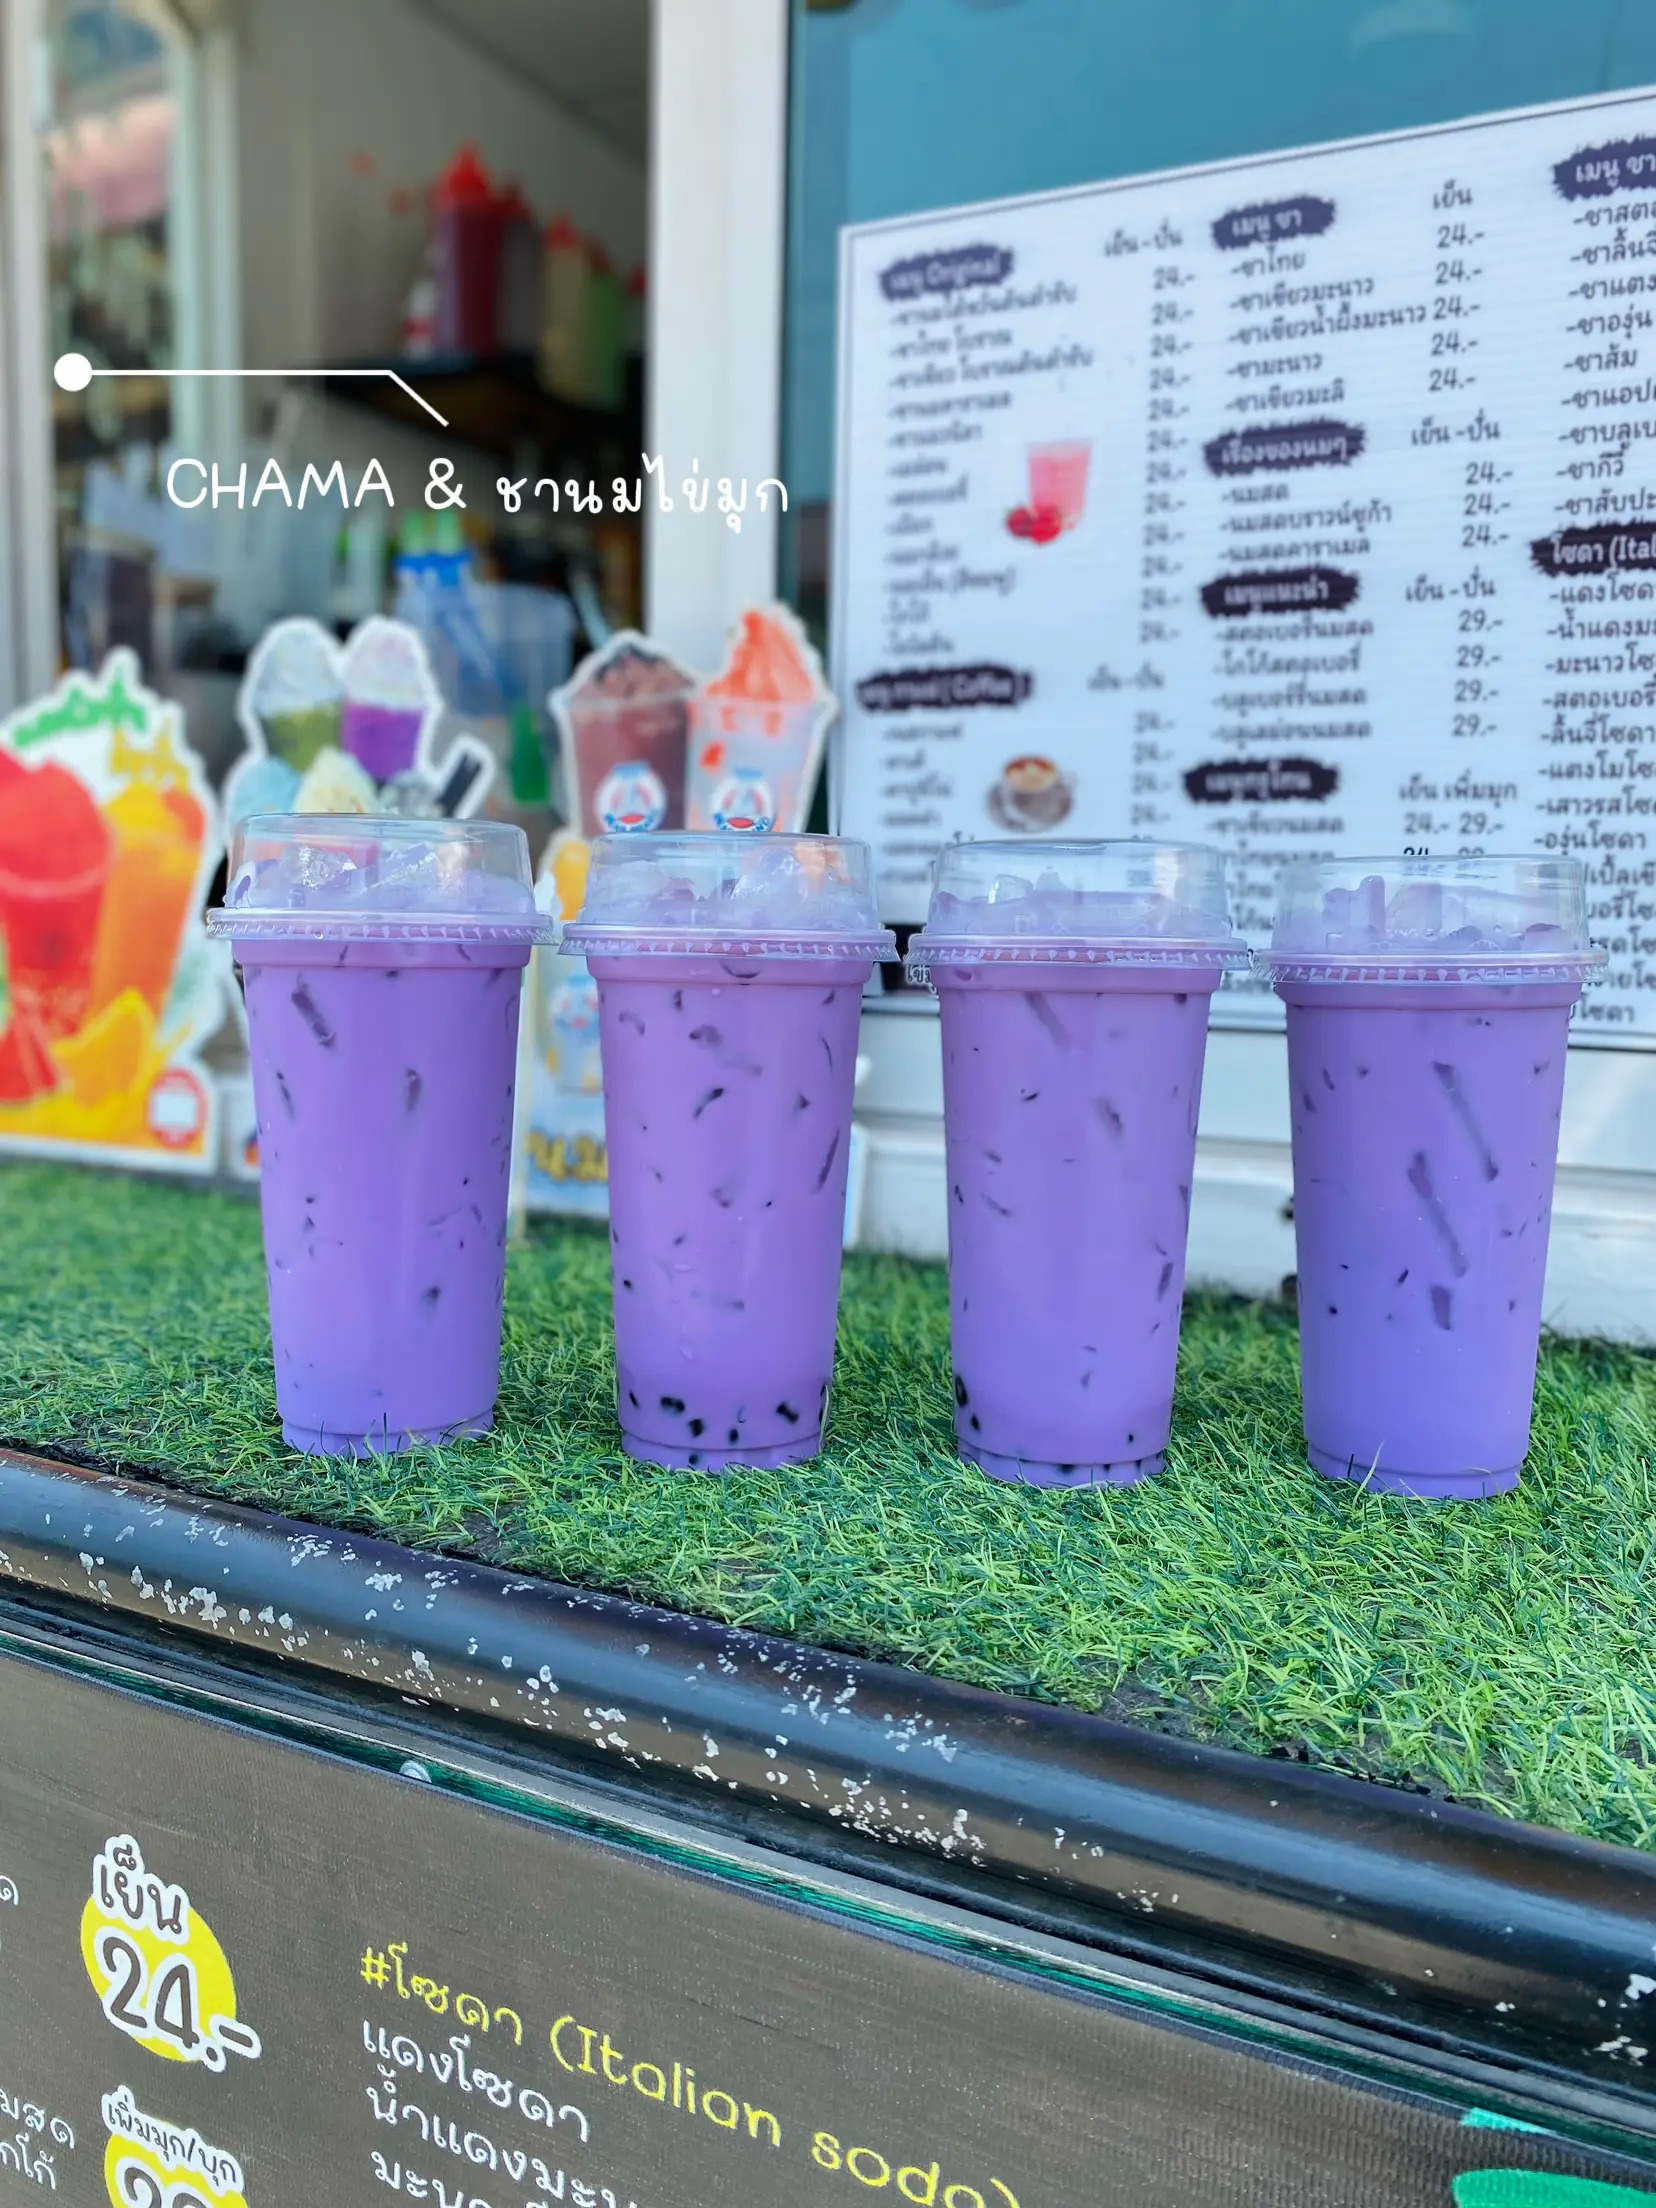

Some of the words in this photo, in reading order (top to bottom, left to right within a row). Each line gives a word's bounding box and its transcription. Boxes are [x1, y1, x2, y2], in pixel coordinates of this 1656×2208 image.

[1576, 158, 1620, 188] เมนู
[1433, 178, 1474, 211] เย็น
[1232, 213, 1271, 243] เมนู
[1274, 208, 1303, 231] ชา
[1436, 223, 1485, 249] 24.-
[1153, 265, 1196, 291] 24.-
[1435, 260, 1482, 286] 24.-
[1151, 301, 1194, 326] 24.-
[1432, 295, 1480, 321] 24.-
[1565, 302, 1654, 340] -ชาองุ่น
[1430, 331, 1478, 356] 24.-
[1563, 342, 1638, 373] -ชาส้ม
[1428, 367, 1476, 392] 24.-
[1465, 461, 1513, 486] 24.-
[1555, 450, 1625, 480] -ชากีวี
[1463, 492, 1511, 517] 24.-
[1461, 524, 1509, 549] 24.-
[1550, 531, 1605, 565] โซดา
[1458, 609, 1503, 633] 29.-
[1456, 644, 1501, 668] 29.-
[1453, 679, 1499, 703] 29.-
[1451, 713, 1497, 738] 29.-
[1399, 772, 1438, 801] เย็น
[1444, 767, 1518, 810] เพิ่มมุก
[1404, 812, 1450, 836] 24.-
[1458, 812, 1505, 836] 29.-
[1534, 819, 1647, 857] -องุ่นโซดา
[100, 1845, 183, 1936] เย็น
[101, 1934, 256, 2064] 24.-
[360, 1941, 524, 2047] #โซดา
[547, 2014, 783, 2149] (Italian
[362, 2018, 591, 2143] แดงโซดา
[107, 2093, 238, 2188] เพิ่มมุก/บุก
